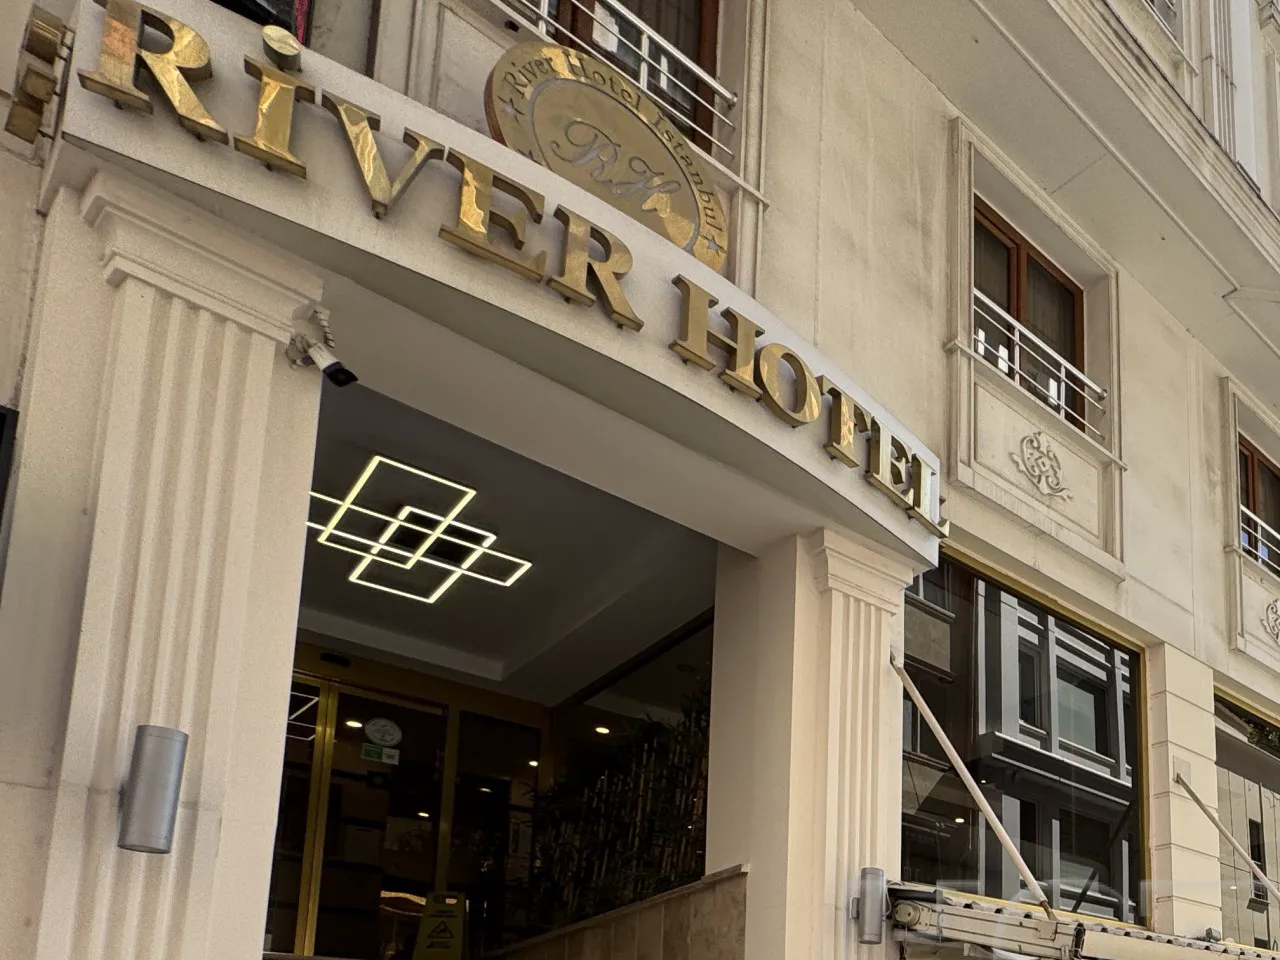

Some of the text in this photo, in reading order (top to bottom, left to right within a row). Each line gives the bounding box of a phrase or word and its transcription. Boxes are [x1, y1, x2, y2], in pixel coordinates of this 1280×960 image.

[503, 49, 724, 234] River Hotel Istanbul
[669, 273, 949, 538] HOTEL
